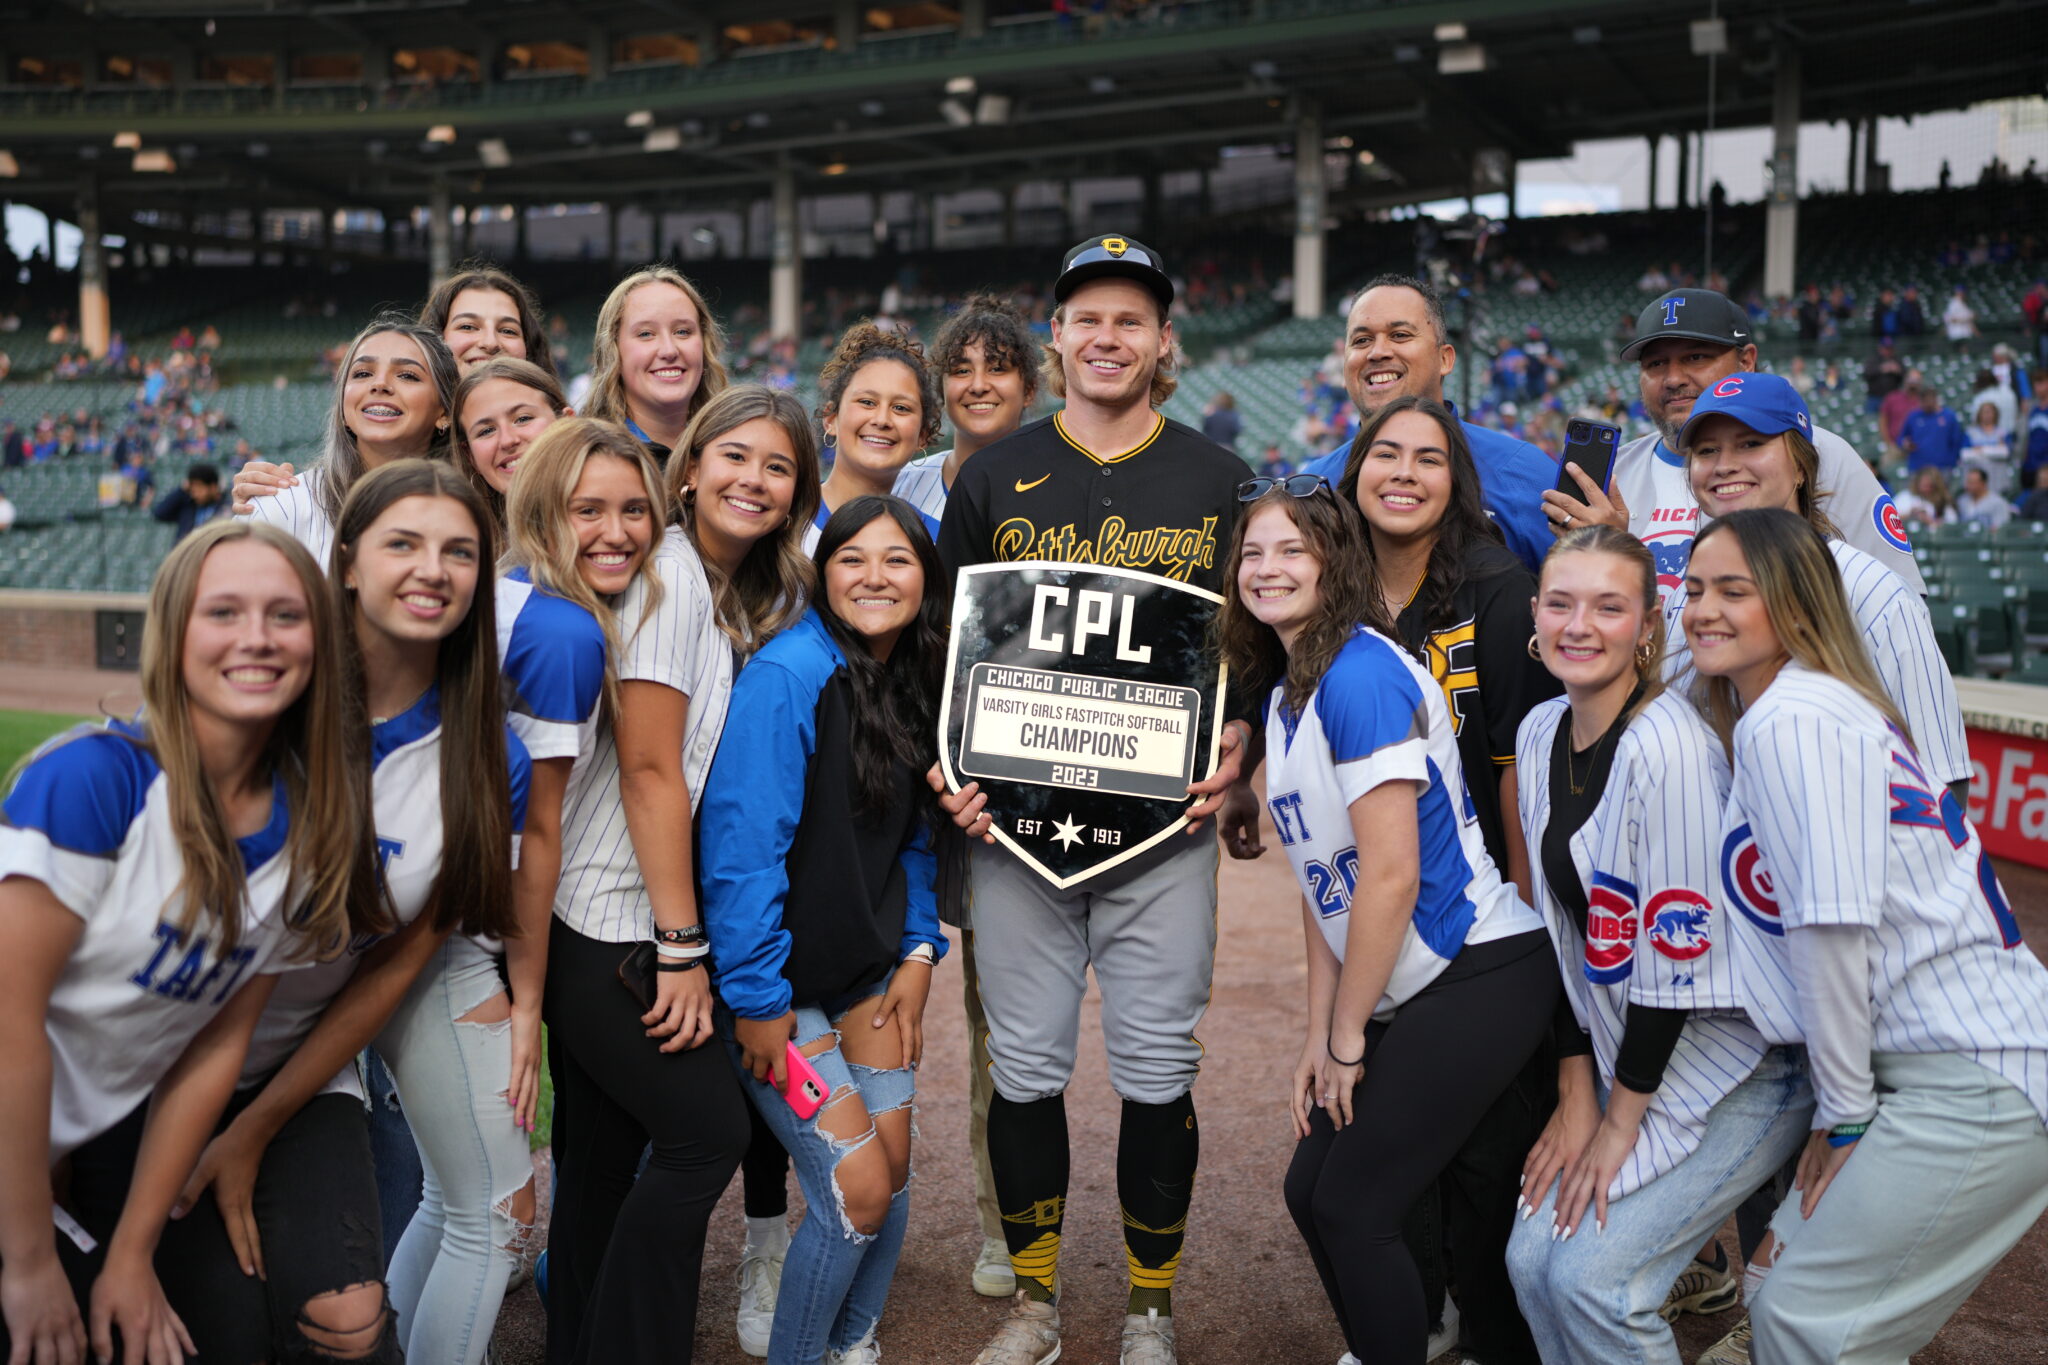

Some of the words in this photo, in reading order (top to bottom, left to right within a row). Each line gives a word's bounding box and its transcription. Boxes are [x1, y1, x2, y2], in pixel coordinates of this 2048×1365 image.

[1661, 296, 1686, 326] T
[1712, 377, 1744, 399] C
[1649, 507, 1698, 522] HICA
[993, 516, 1218, 582] Pttsburgh
[1028, 584, 1152, 664] CPL
[987, 668, 1054, 692] CHICAGO
[1061, 677, 1118, 700] PUBLIC
[1125, 685, 1185, 708] LEAGUE
[983, 696, 1029, 716] VARSITY
[1031, 702, 1063, 720] GIRLS
[1065, 707, 1125, 728] FASTPITCH
[1127, 714, 1182, 735] SOFTBALL
[1020, 722, 1139, 760] CHAMPIONS
[1051, 765, 1099, 788] 2023
[1016, 819, 1043, 836] EST
[1093, 827, 1121, 846] 1913
[129, 920, 258, 1006] TAFT
